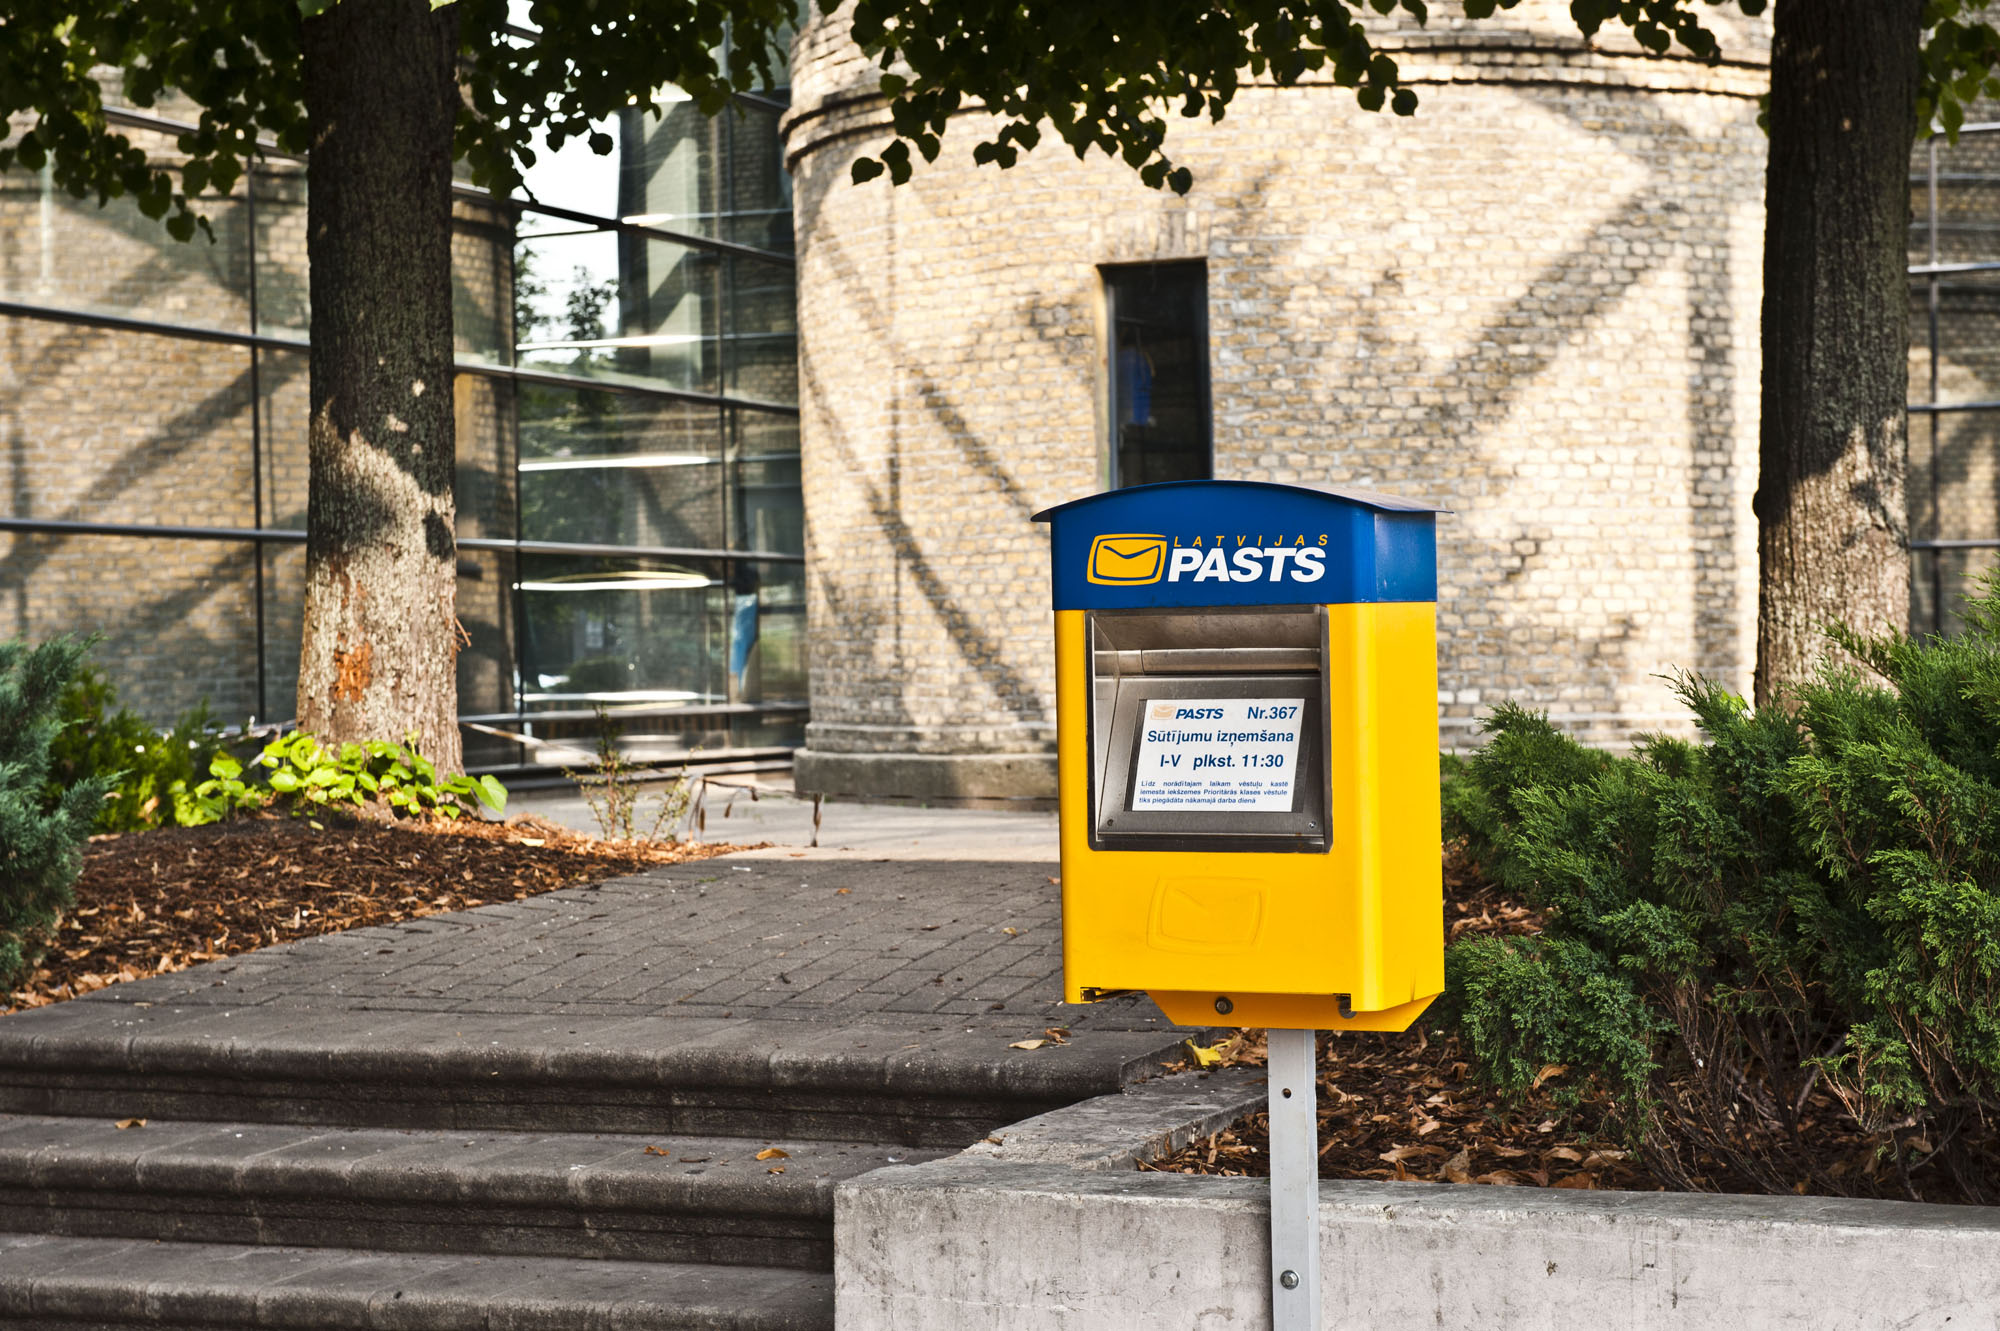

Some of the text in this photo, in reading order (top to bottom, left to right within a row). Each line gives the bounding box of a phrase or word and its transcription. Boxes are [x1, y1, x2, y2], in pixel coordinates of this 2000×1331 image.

[1173, 534, 1329, 547] LATVIJAS
[1167, 546, 1327, 583] PASTS
[1175, 706, 1298, 720] PASTS Nr.367
[1147, 729, 1295, 747] Sūtījumu izņemšana
[1160, 754, 1284, 770] I-V plkst. 11:30
[1152, 797, 1184, 805] piegādāta
